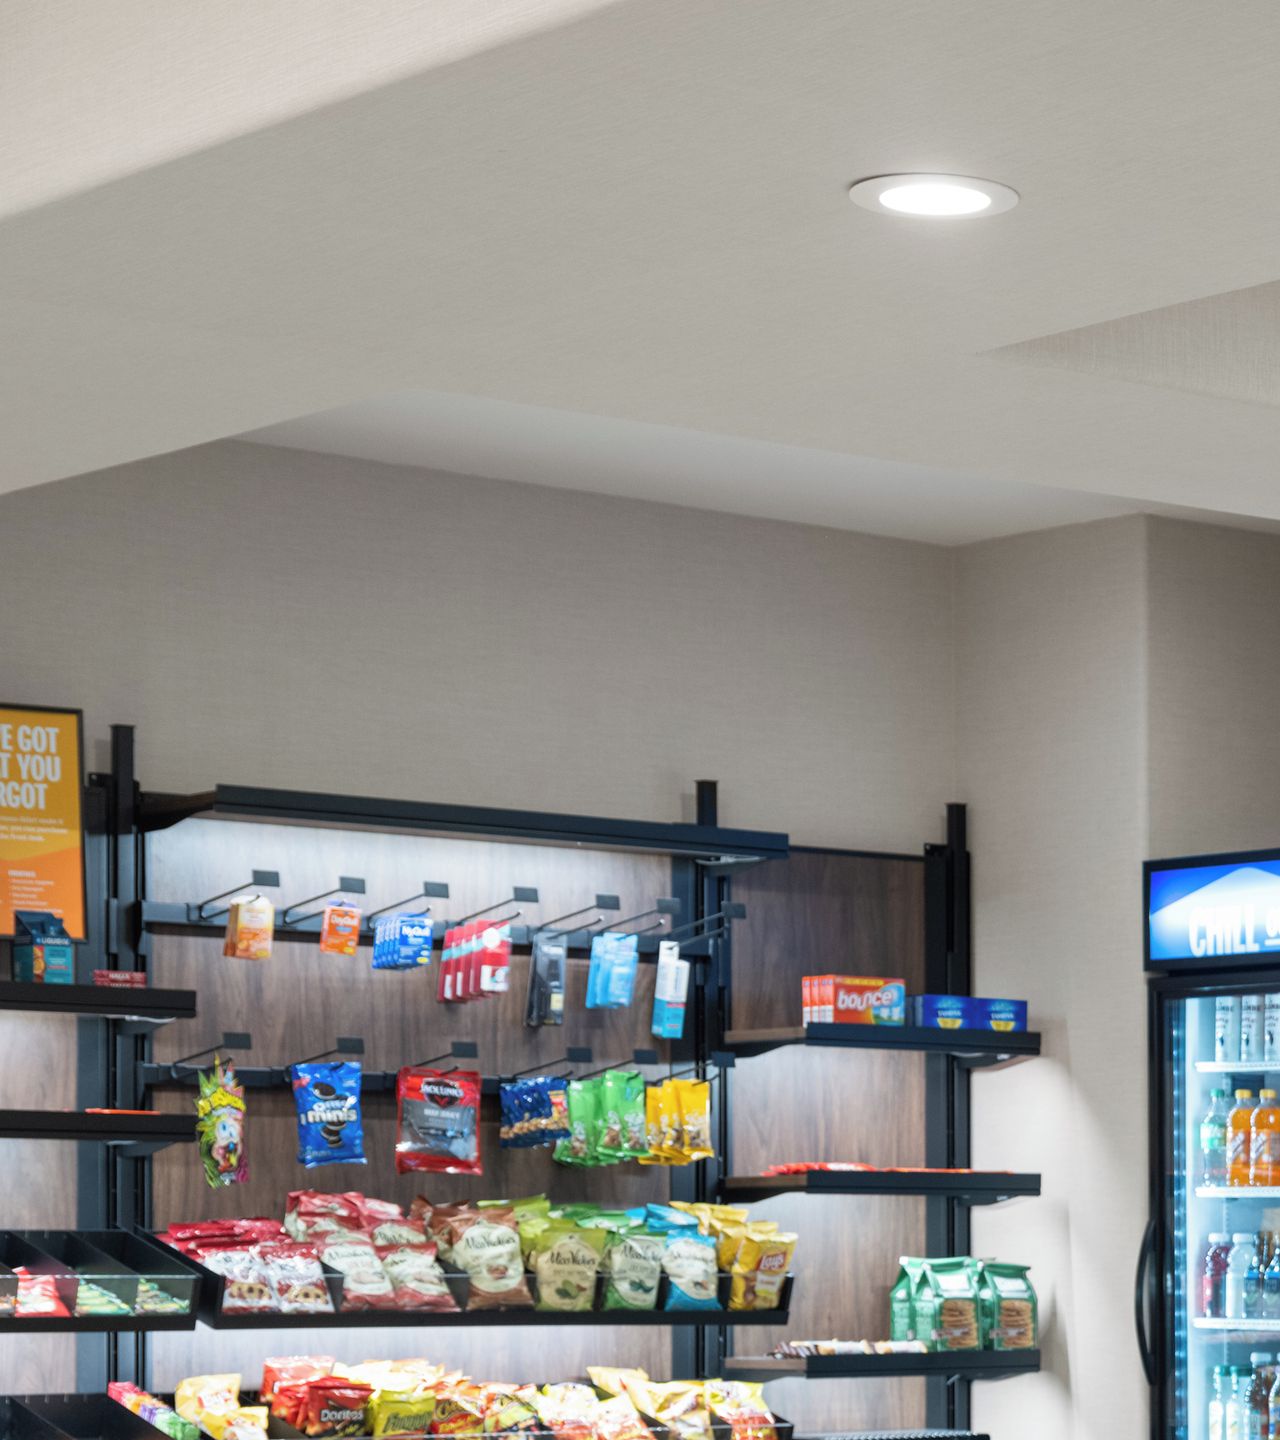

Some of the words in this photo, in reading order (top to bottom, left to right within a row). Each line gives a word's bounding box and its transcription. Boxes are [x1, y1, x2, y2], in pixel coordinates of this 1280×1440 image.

[17, 724, 59, 753] GOT
[16, 753, 62, 783] YOU
[1189, 903, 1260, 957] CHILL
[837, 989, 892, 1011] bounce
[321, 1409, 363, 1421] Doritos
